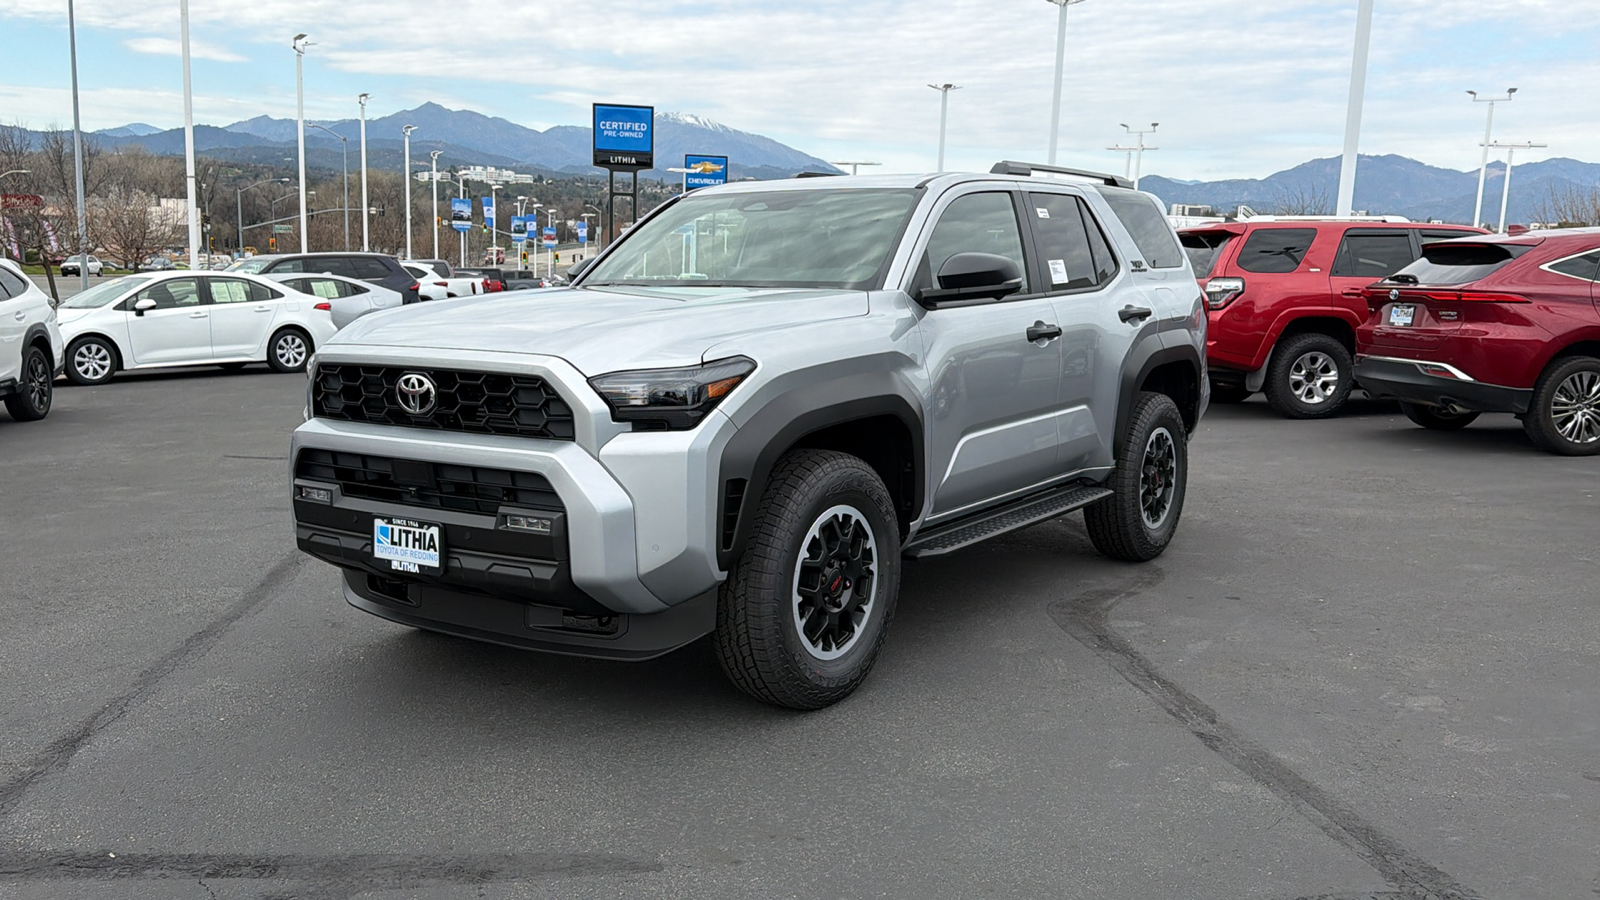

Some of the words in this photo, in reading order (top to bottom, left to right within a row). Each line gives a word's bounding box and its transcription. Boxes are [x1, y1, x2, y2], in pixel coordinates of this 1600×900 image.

[600, 121, 647, 131] CERTIFIED
[604, 130, 643, 138] PRE-OWNED
[610, 156, 636, 164] LITHIA
[392, 518, 406, 526] SINCE
[391, 527, 438, 552] LITHIA
[376, 544, 399, 556] TOYOTA
[400, 549, 408, 557] OF
[410, 550, 438, 562] REDDING
[399, 561, 419, 573] LITHIA
